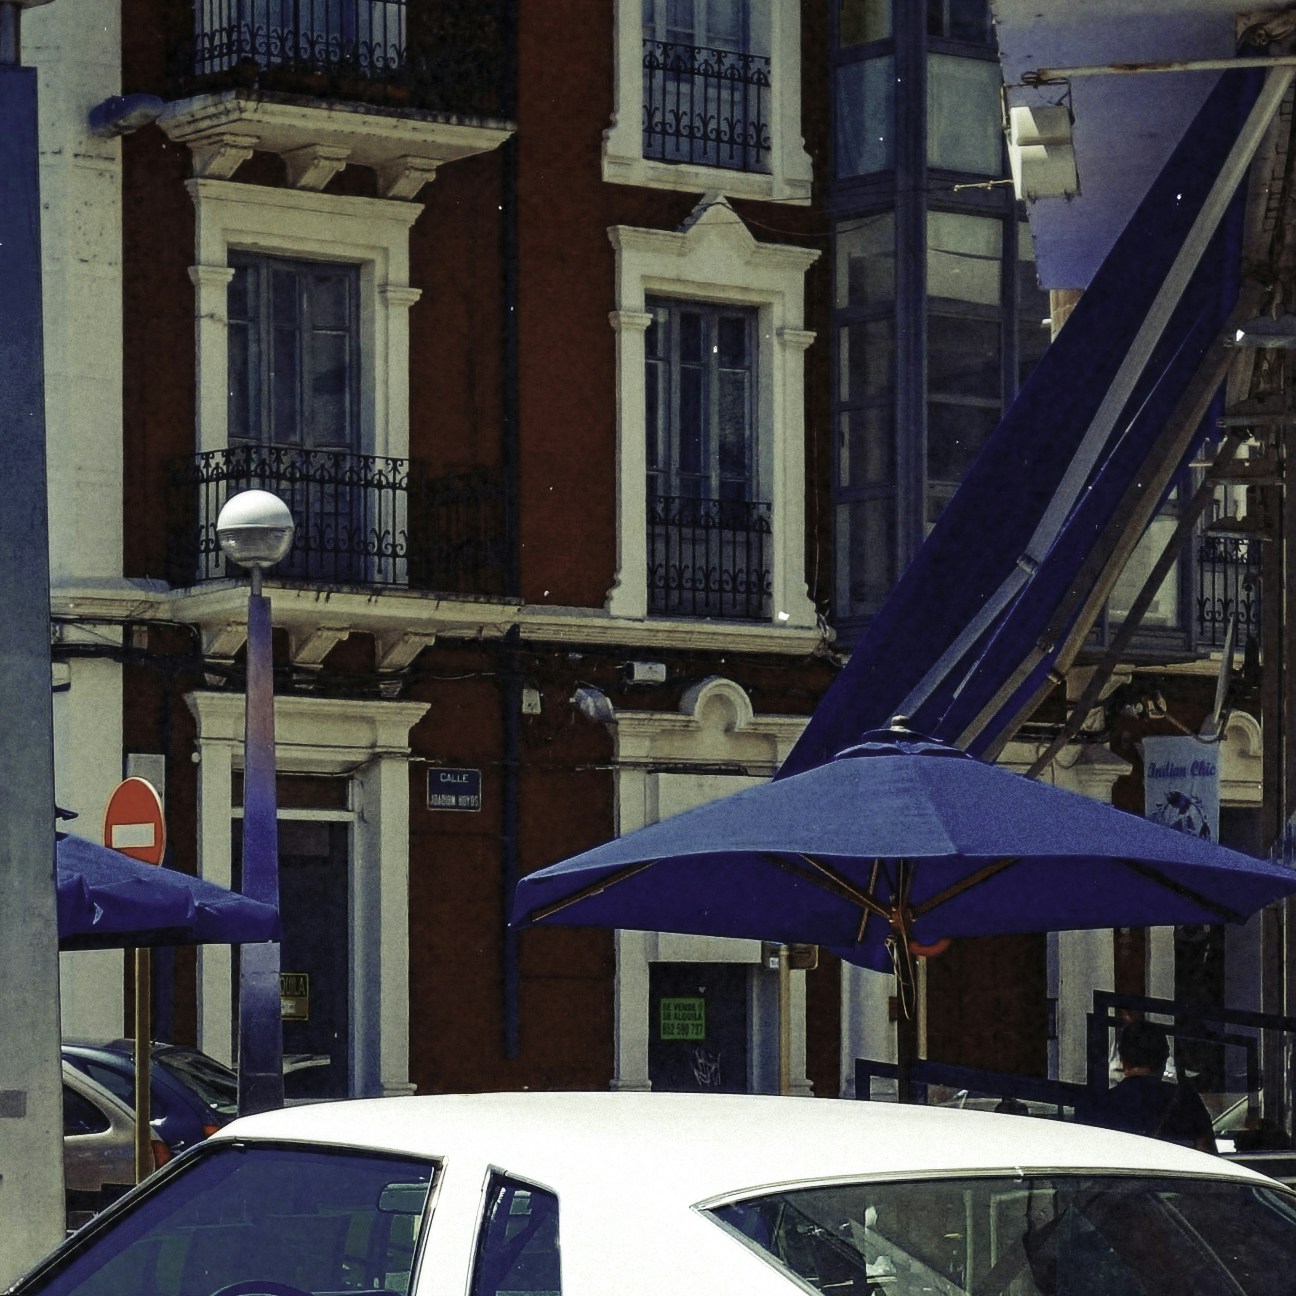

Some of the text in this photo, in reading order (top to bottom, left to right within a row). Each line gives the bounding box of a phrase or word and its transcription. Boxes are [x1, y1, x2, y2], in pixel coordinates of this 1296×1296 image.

[1148, 760, 1216, 778] Indian Chic
[440, 772, 469, 783] CALLE
